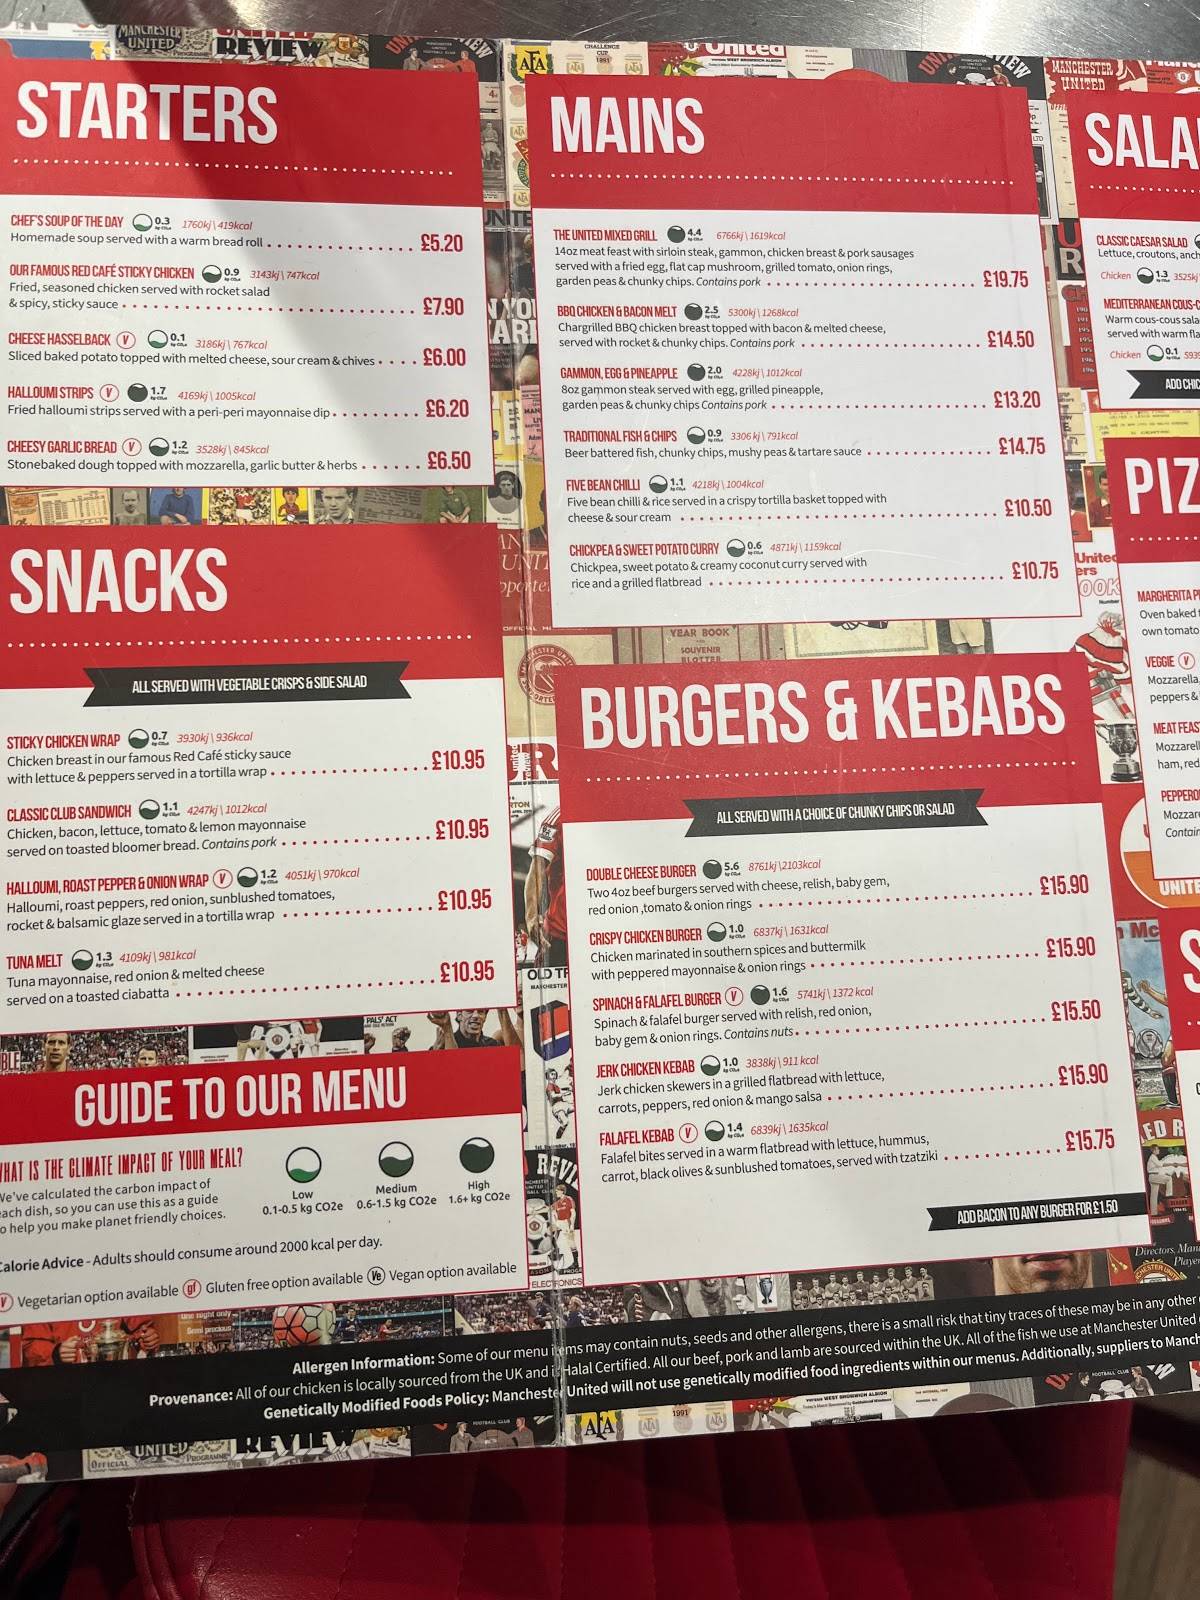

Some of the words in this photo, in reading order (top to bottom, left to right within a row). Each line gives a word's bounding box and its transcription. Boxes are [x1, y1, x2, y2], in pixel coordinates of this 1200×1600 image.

[118, 26, 182, 39] MANCHESTER
[128, 38, 175, 50] UNITED
[216, 38, 323, 60] REVIEW
[705, 43, 784, 57] United
[1052, 61, 1113, 76] MANCHESTER
[1061, 76, 1105, 91] UNITED
[16, 80, 277, 144] STARTERS
[551, 96, 704, 154] MAINS
[1084, 112, 1200, 170] SALA
[11, 214, 43, 226] CHEF'S
[45, 215, 70, 226] SOUP
[71, 215, 83, 226] OF
[84, 216, 103, 227] THE
[105, 216, 123, 227] DAY
[11, 232, 75, 242] Homemade
[77, 235, 104, 245] soup
[106, 234, 142, 244] served
[144, 234, 168, 244] with
[212, 236, 243, 246] bread
[245, 236, 265, 247] roll
[421, 233, 463, 252] £5.20
[553, 229, 570, 240] THE
[572, 229, 603, 240] UNITED
[604, 229, 632, 241] MIXED
[634, 230, 657, 241] GRILL
[1096, 235, 1129, 246] CLASSIC
[1130, 236, 1161, 247] CAESAR
[1162, 237, 1188, 248] SALAD
[983, 270, 1028, 287] £19.75
[423, 297, 464, 315] £7.90
[8, 332, 45, 344] CHEESE
[47, 333, 110, 346] HASSELBACK
[987, 330, 1034, 348] £14.50
[423, 348, 466, 366] £6.00
[426, 399, 469, 417] £6.20
[994, 390, 1040, 408] £13.20
[999, 437, 1045, 455] £14.75
[428, 451, 470, 469] £6.50
[1004, 498, 1052, 516] £10.50
[1012, 561, 1058, 579] £10.75
[10, 548, 227, 613] SNACKS
[1138, 590, 1192, 602] MARGHERITA
[670, 629, 697, 638] YEAR
[702, 628, 730, 637] BOOK
[1145, 655, 1175, 668] VEGGIE
[132, 680, 150, 693] ALL
[151, 679, 189, 693] SERVED
[190, 679, 215, 691] WITH
[216, 678, 270, 691] VEGETABLE
[271, 677, 304, 690] CRISPS
[306, 676, 313, 689] &
[314, 676, 335, 688] SIDE
[336, 675, 367, 688] SALAD
[581, 681, 809, 749] BURGERS
[824, 680, 858, 741] &
[871, 674, 1065, 739] KEBABS
[432, 749, 484, 770] £10.95
[512, 744, 520, 772] united
[7, 807, 48, 821] CLASSIC
[50, 806, 76, 820] CLUB
[78, 804, 131, 819] SANDWICH
[717, 811, 734, 824] ALL
[734, 810, 769, 823] SERVED
[770, 809, 793, 821] WITH
[795, 808, 802, 820] A
[802, 807, 835, 820] CHOICE
[835, 806, 846, 819] OF
[848, 805, 884, 818] CHUNKY
[886, 804, 912, 817] CHIPS
[913, 804, 925, 816] OR
[926, 803, 954, 815] SALAD
[436, 818, 488, 840] £10.95
[1040, 874, 1088, 895] £15.90
[438, 888, 491, 910] £10.95
[1046, 936, 1095, 958] £15.90
[6, 977, 35, 988] Tuna
[38, 971, 112, 988] mayonnaise,
[114, 970, 133, 982] red
[136, 969, 168, 981] onion
[171, 969, 180, 979] &
[182, 966, 222, 979] melted
[224, 965, 264, 976] cheese
[440, 960, 494, 982] £10.95
[528, 969, 552, 981] OLD
[1051, 999, 1101, 1021] £15.50
[367, 1016, 384, 1024] PALS'
[596, 1064, 619, 1078] JERK
[620, 1061, 661, 1076] CHICKEN
[663, 1060, 694, 1074] KEBAB
[1058, 1063, 1108, 1086] £15.90
[75, 1080, 173, 1126] GUIDE
[182, 1077, 225, 1119] TO
[236, 1073, 302, 1117] OUR
[312, 1066, 406, 1112] MENU
[1065, 1128, 1114, 1151] £15.75
[29, 1160, 39, 1180] IS
[44, 1158, 63, 1179] THE
[69, 1155, 112, 1178] CLIMATE
[118, 1152, 156, 1174] IMPACT
[161, 1151, 173, 1172] OF
[179, 1149, 204, 1170] YOUR
[210, 1147, 242, 1168] MEAL?
[292, 1190, 313, 1199] Low
[376, 1183, 417, 1194] Medium
[468, 1180, 489, 1191] High
[357, 1198, 391, 1209] 0.6-1.5
[394, 1197, 405, 1208] kg
[409, 1196, 436, 1206] CO2e
[449, 1194, 468, 1203] 1.6+
[471, 1190, 482, 1204] kg
[484, 1192, 510, 1201] CO2e
[262, 1204, 297, 1215] 0.1-0.5
[300, 1203, 312, 1214] kg
[315, 1201, 343, 1212] CO2e
[958, 1210, 976, 1224] ADD
[976, 1207, 1008, 1222] BACON
[1008, 1206, 1020, 1220] TO
[1021, 1205, 1038, 1219] ANY
[1040, 1203, 1075, 1218] BURGER
[1075, 1201, 1092, 1215] FOR
[1093, 1199, 1118, 1214] £1.50
[1135, 1246, 1175, 1257] Directors,
[292, 1361, 348, 1375] Allergen
[351, 1353, 434, 1370] Information:
[438, 1352, 473, 1364] Some
[476, 1348, 488, 1361] of
[490, 1350, 511, 1360] our
[514, 1348, 548, 1358] menu
[672, 1409, 688, 1417] 1991
[135, 1443, 189, 1457] UNITED
[186, 1453, 229, 1462] PROGRAMME
[90, 1459, 129, 1470] OFFICIAL
